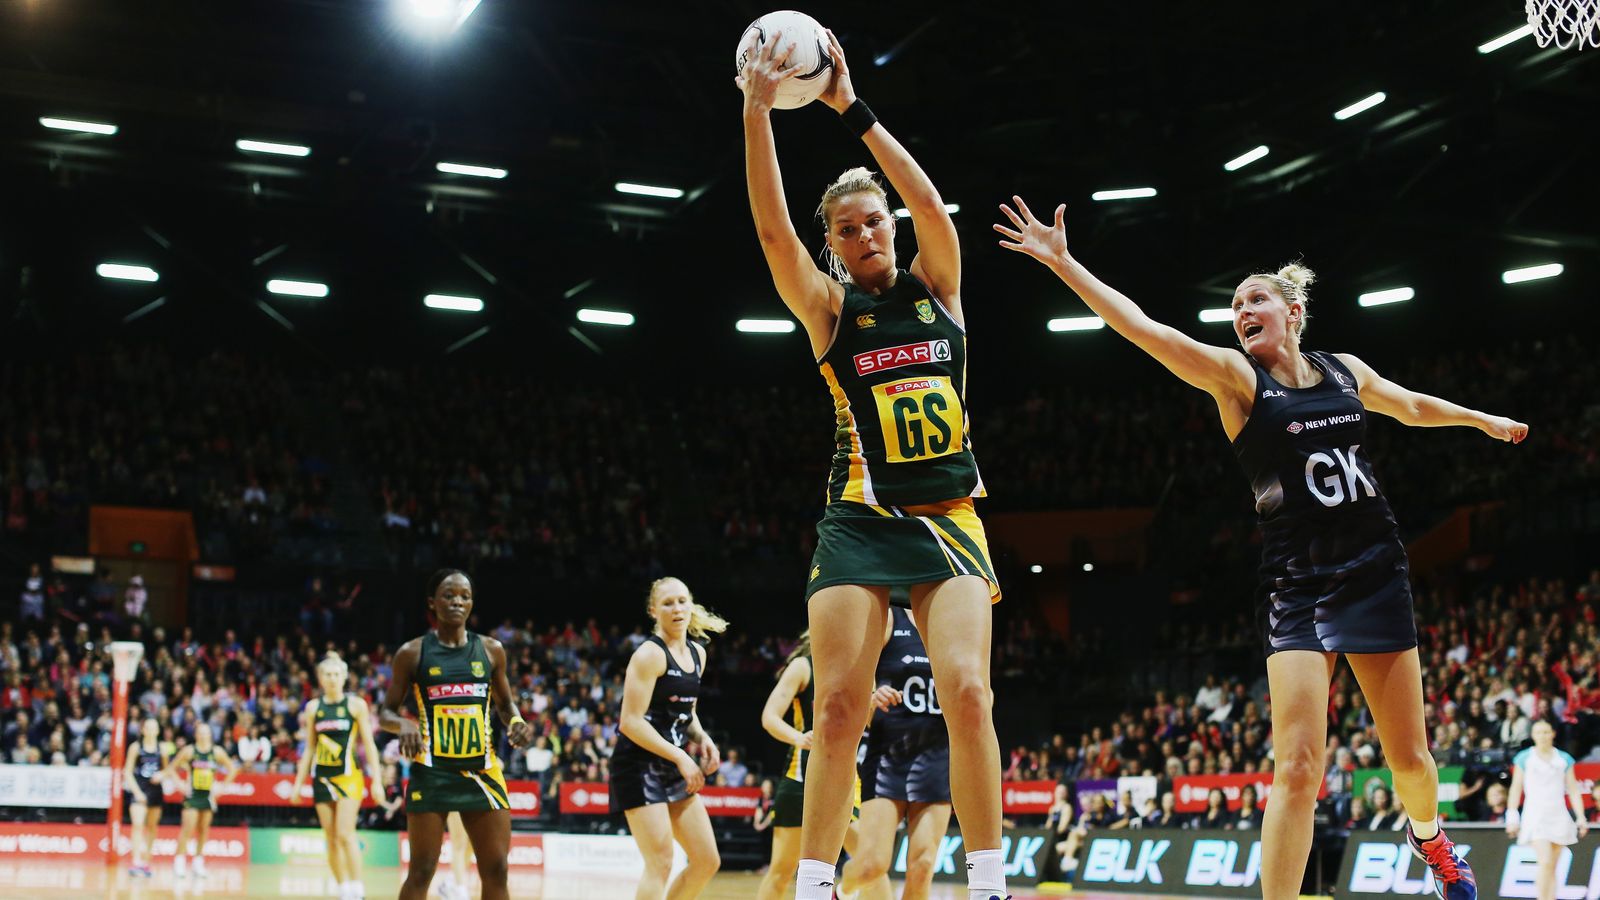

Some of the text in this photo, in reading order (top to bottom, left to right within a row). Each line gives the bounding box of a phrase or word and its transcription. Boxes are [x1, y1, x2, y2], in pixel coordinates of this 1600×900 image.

[858, 345, 930, 371] SPAR
[895, 381, 930, 393] SPAR
[1262, 389, 1287, 399] BLK
[892, 392, 952, 459] GS
[1305, 418, 1327, 430] NEW
[1328, 413, 1361, 426] WORLD
[1305, 444, 1377, 507] GK
[437, 717, 482, 755] WA
[1083, 838, 1170, 884] BLK
